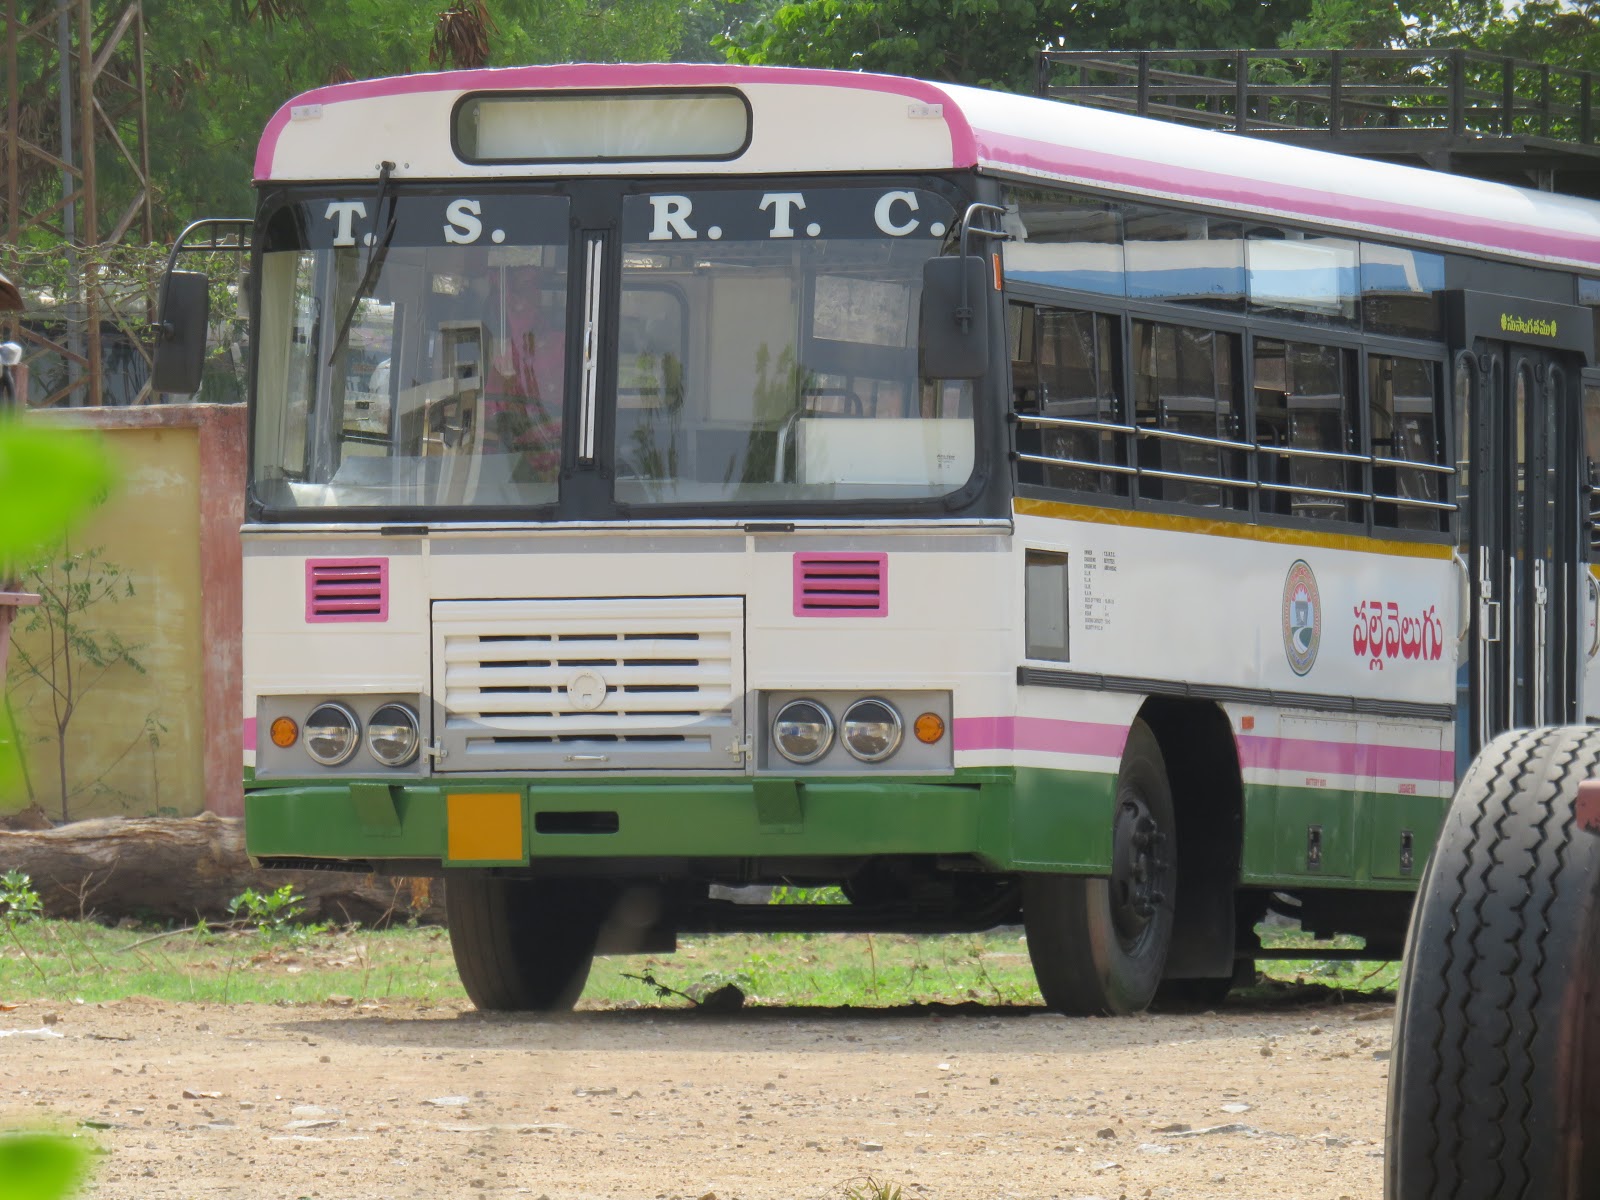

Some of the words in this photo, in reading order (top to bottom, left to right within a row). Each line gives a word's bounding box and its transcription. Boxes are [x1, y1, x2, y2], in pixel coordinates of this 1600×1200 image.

[324, 202, 378, 247] T.
[443, 198, 506, 245] S.
[648, 195, 723, 241] R.
[758, 192, 821, 238] T.
[874, 190, 946, 237] C.
[1353, 600, 1443, 671] పల్లెవెలుగు
